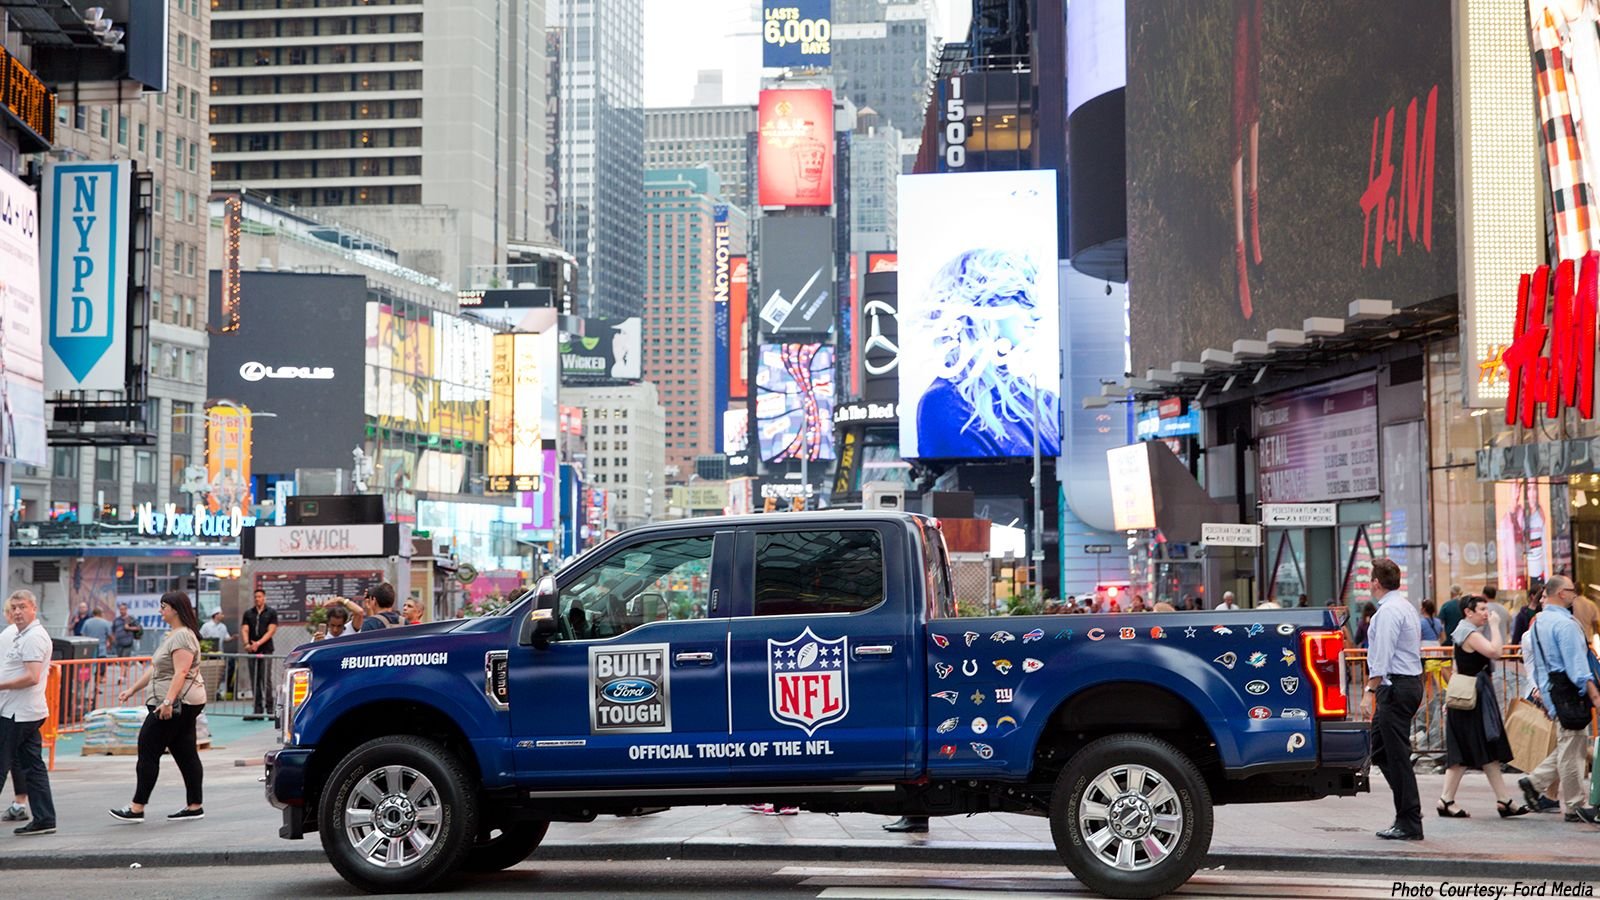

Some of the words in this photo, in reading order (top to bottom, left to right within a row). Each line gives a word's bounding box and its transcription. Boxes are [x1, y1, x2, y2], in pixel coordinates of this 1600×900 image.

[765, 8, 799, 20] LASTS
[764, 19, 831, 47] 6,000
[801, 42, 831, 54] DAYS
[946, 77, 965, 168] 1500
[1359, 84, 1438, 269] H&M
[71, 176, 98, 333] NYPD
[714, 222, 729, 302] NOVOTEL
[1502, 250, 1599, 429] H&M
[562, 354, 606, 369] WICKED
[868, 402, 894, 419] Red
[214, 430, 245, 444] GMP
[138, 501, 165, 534] NEW
[165, 503, 193, 535] YORK
[195, 503, 230, 536] POLICE
[290, 528, 350, 549] S'WICH
[341, 652, 448, 670] #BUILTFORDTOUGH
[598, 653, 661, 678] BUILT
[612, 683, 645, 698] Ford
[779, 674, 839, 720] NFL
[598, 704, 662, 724] TOUGH
[629, 744, 693, 760] OFFICIAL
[696, 743, 746, 759] TRUCK
[749, 742, 769, 757] OF
[772, 741, 801, 756] THE
[805, 741, 834, 756] NFL
